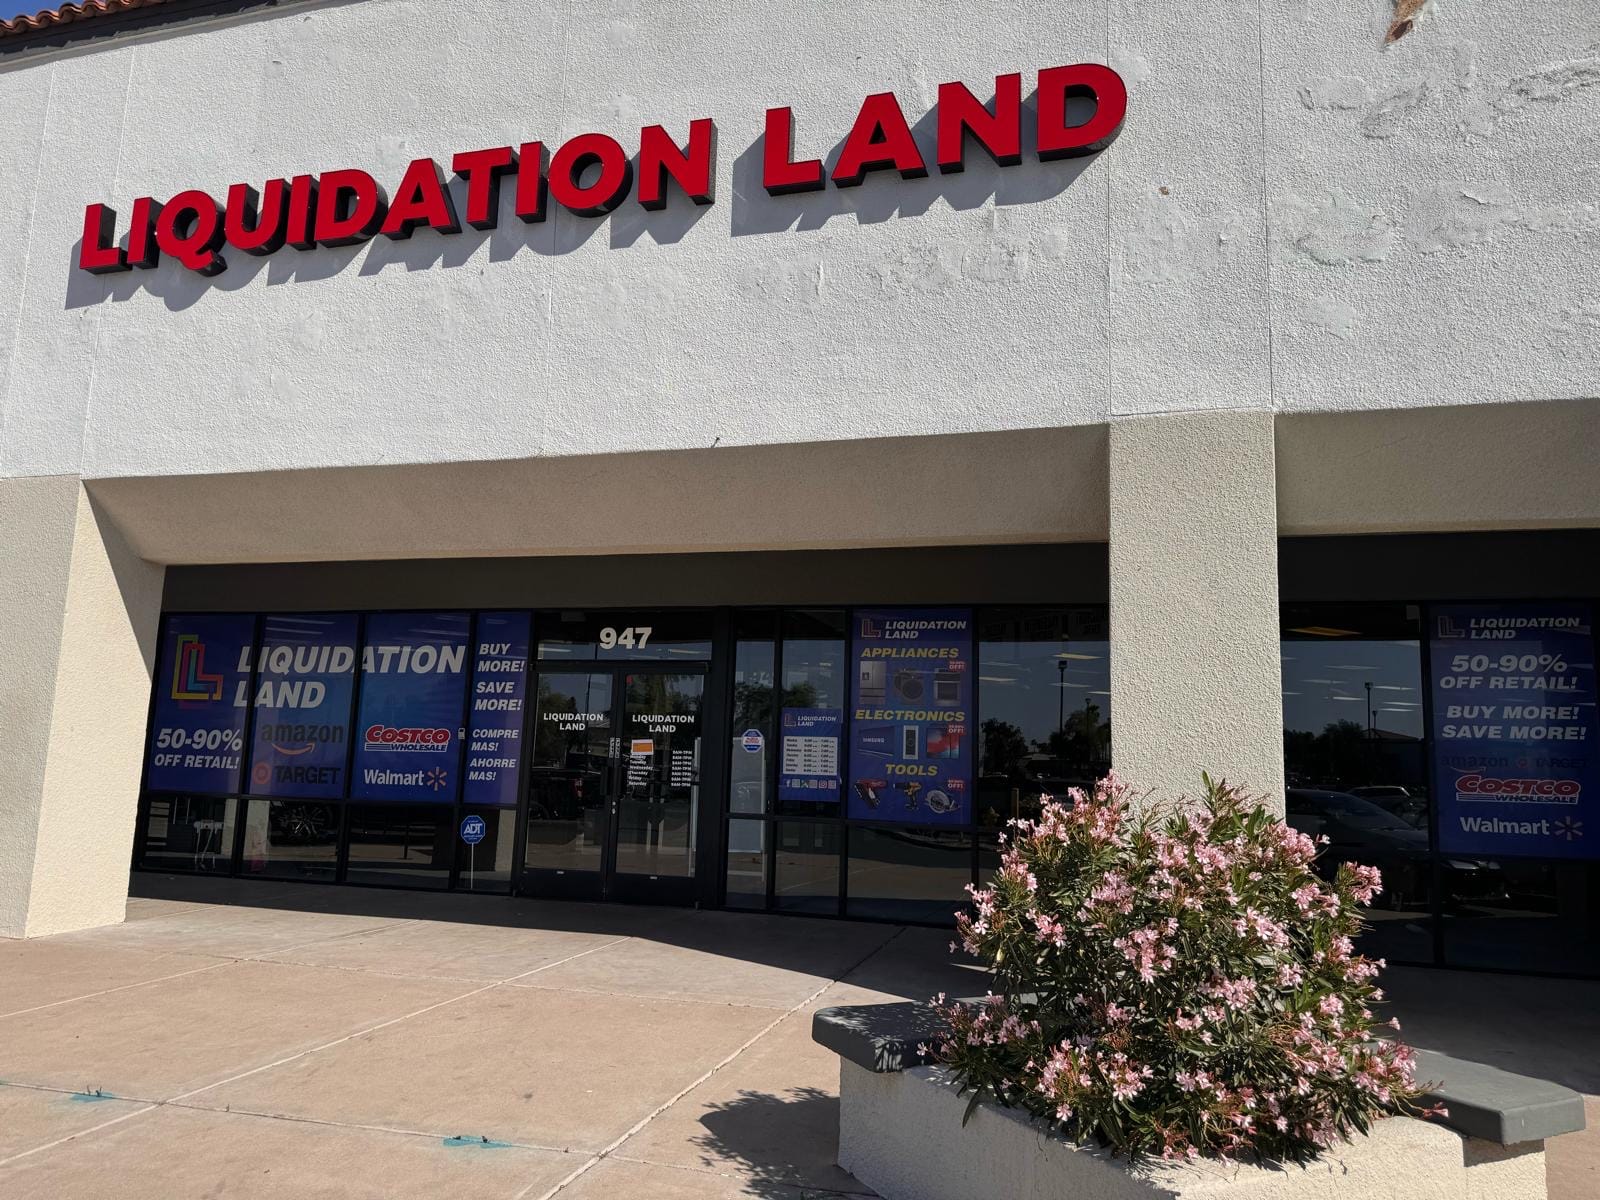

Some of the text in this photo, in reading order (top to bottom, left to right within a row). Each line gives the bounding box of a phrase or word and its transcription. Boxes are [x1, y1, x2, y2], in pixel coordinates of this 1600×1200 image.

[80, 62, 1128, 277] LIQUIDATION LAND
[885, 621, 967, 630] LIQUIDATION
[1470, 617, 1580, 628] LIQUIDATION
[599, 627, 653, 650] 947
[885, 630, 919, 639] LAND
[1470, 629, 1516, 639] LAND
[479, 643, 511, 655] BUY
[860, 647, 960, 659] APPLIANCES
[237, 645, 466, 675] LIQUIDATION
[1450, 653, 1568, 673] 50-90%
[478, 660, 526, 673] MORE!
[475, 681, 514, 693] SAVE
[1440, 676, 1578, 690] OFF RETAIL!
[233, 680, 327, 709] LAND
[474, 699, 522, 711] MORE!
[543, 712, 604, 722] LIQUIDATION
[855, 709, 966, 721] ELECTRONICS
[1446, 705, 1580, 720] BUY MORE!
[632, 714, 695, 724] LIQUIDATION
[261, 723, 344, 743] amazon
[559, 723, 586, 731] LAND
[649, 724, 676, 733] LAND
[1442, 725, 1587, 740] SAVE MORE!
[156, 728, 243, 752] 50-90%
[366, 725, 451, 744] COSTCO
[472, 729, 519, 739] COMPRE
[391, 743, 448, 752] WHOLESALE
[471, 742, 499, 752] MAS!
[154, 754, 240, 769] OFF RETAIL!
[470, 758, 516, 768] AHORRE
[1441, 754, 1588, 768] amazon TARGET
[274, 766, 341, 785] TARGET
[885, 763, 938, 776] TOOLS
[364, 769, 425, 786] Walmart
[468, 771, 497, 781] MAS!
[1456, 774, 1582, 796] COSTCO
[1495, 795, 1578, 804] WHOLESALE
[463, 823, 483, 834] ADT
[1460, 816, 1550, 835] Walmart
